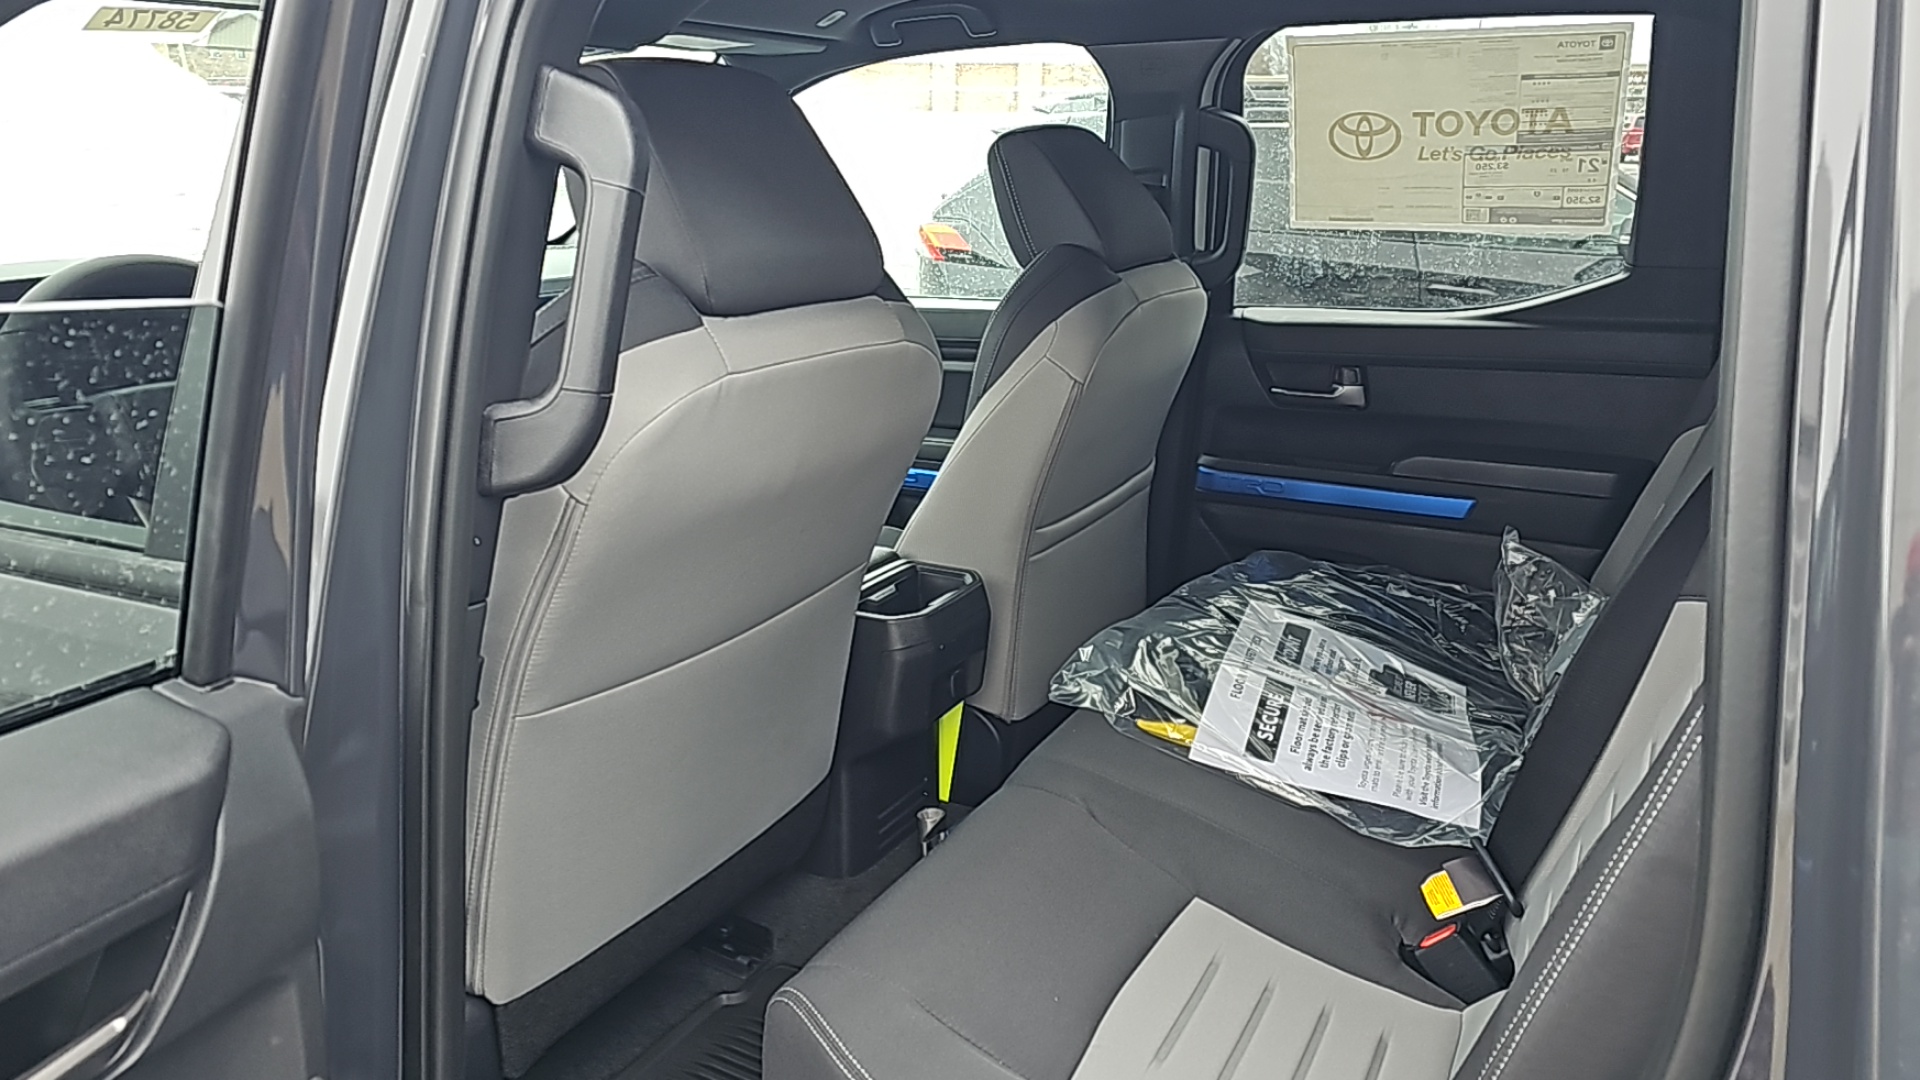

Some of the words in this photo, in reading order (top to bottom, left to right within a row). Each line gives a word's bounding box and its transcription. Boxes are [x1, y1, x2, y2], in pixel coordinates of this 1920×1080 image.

[1411, 107, 1574, 138] TOYOTA
[1418, 145, 1463, 162] Let's
[1254, 690, 1285, 742] SECURE
[1289, 731, 1303, 754] Floor
[1296, 715, 1307, 731] mat
[1307, 731, 1319, 743] be
[1321, 725, 1338, 755] factory
[1341, 739, 1349, 748] or
[1300, 742, 1319, 772] always
[1317, 753, 1330, 769] the
[1334, 747, 1350, 769] clips
[1357, 769, 1369, 789] Toyota
